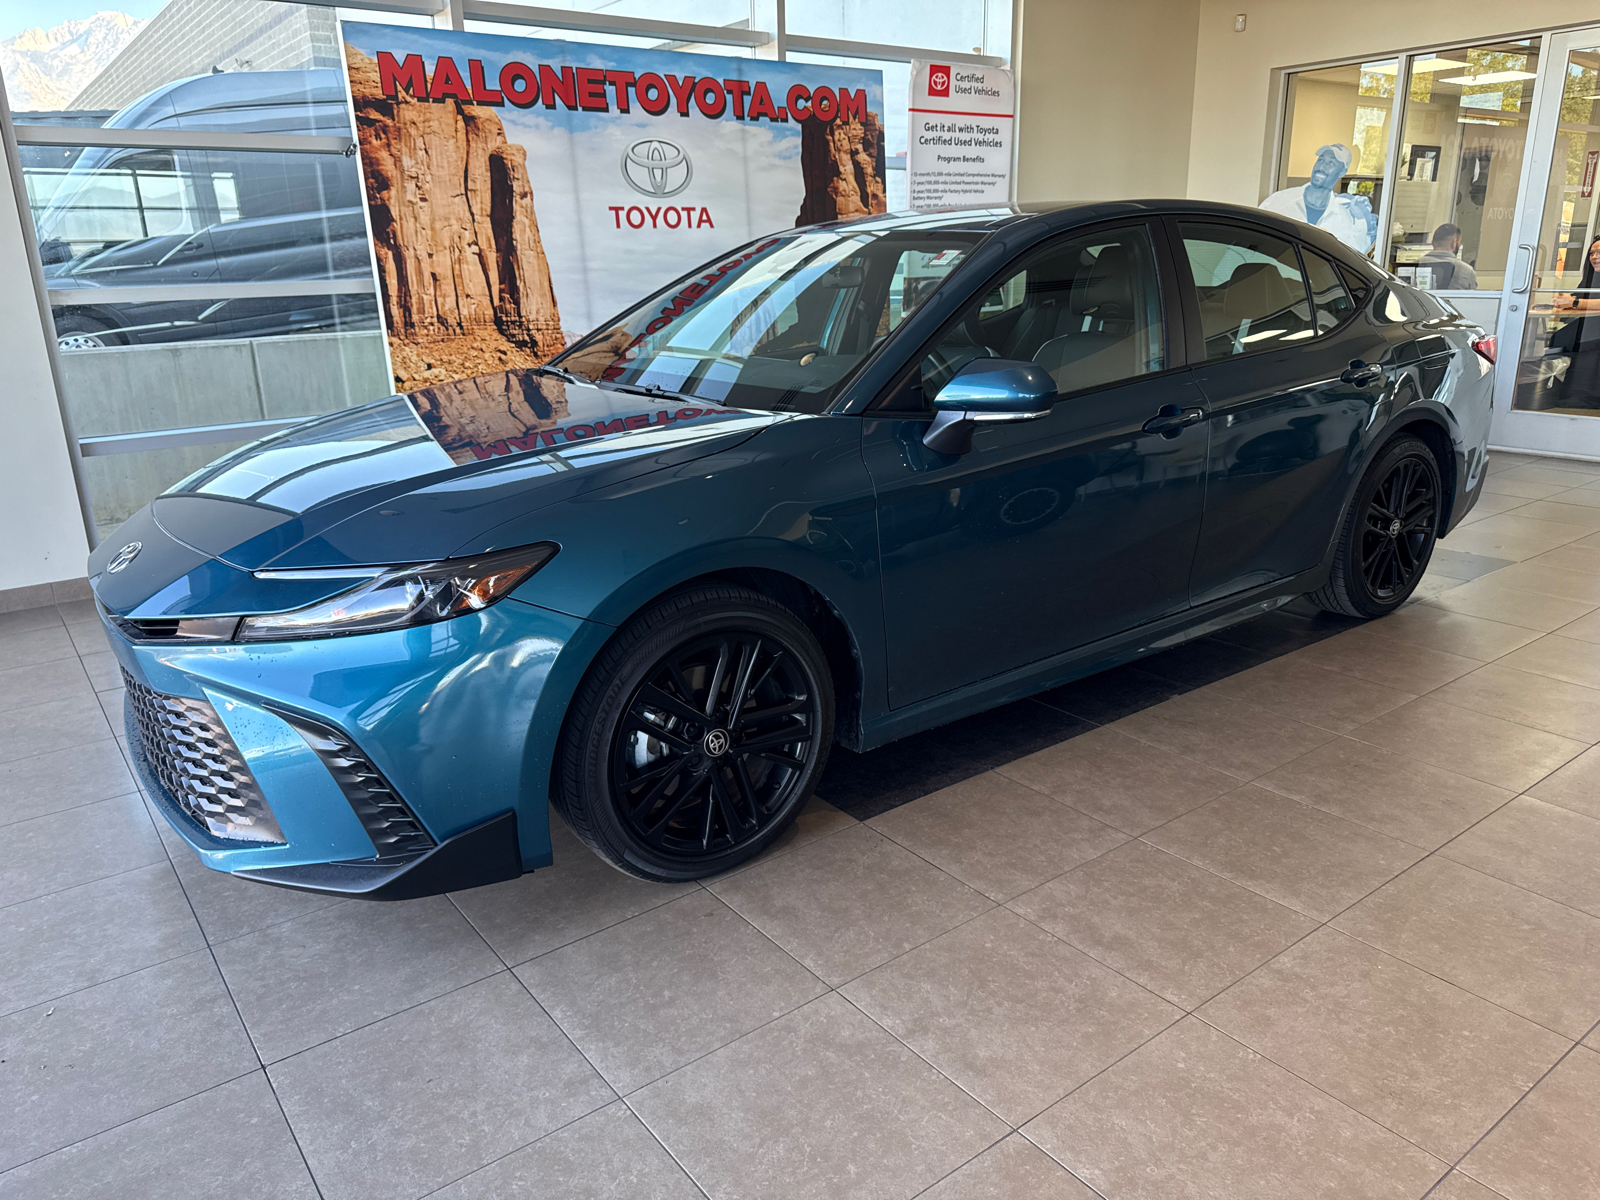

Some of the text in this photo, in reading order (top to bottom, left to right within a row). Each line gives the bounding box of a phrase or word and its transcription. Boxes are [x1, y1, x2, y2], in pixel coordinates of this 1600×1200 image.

[955, 72, 985, 84] Certified
[376, 51, 868, 124] MALONETOYOTA.COM
[954, 84, 1000, 98] Used Vehicles
[923, 122, 999, 137] Get it all with Toyota
[918, 135, 1003, 149] Certified Used Vehicles
[936, 154, 985, 165] Program Benefits
[607, 205, 716, 230] TOYOTA
